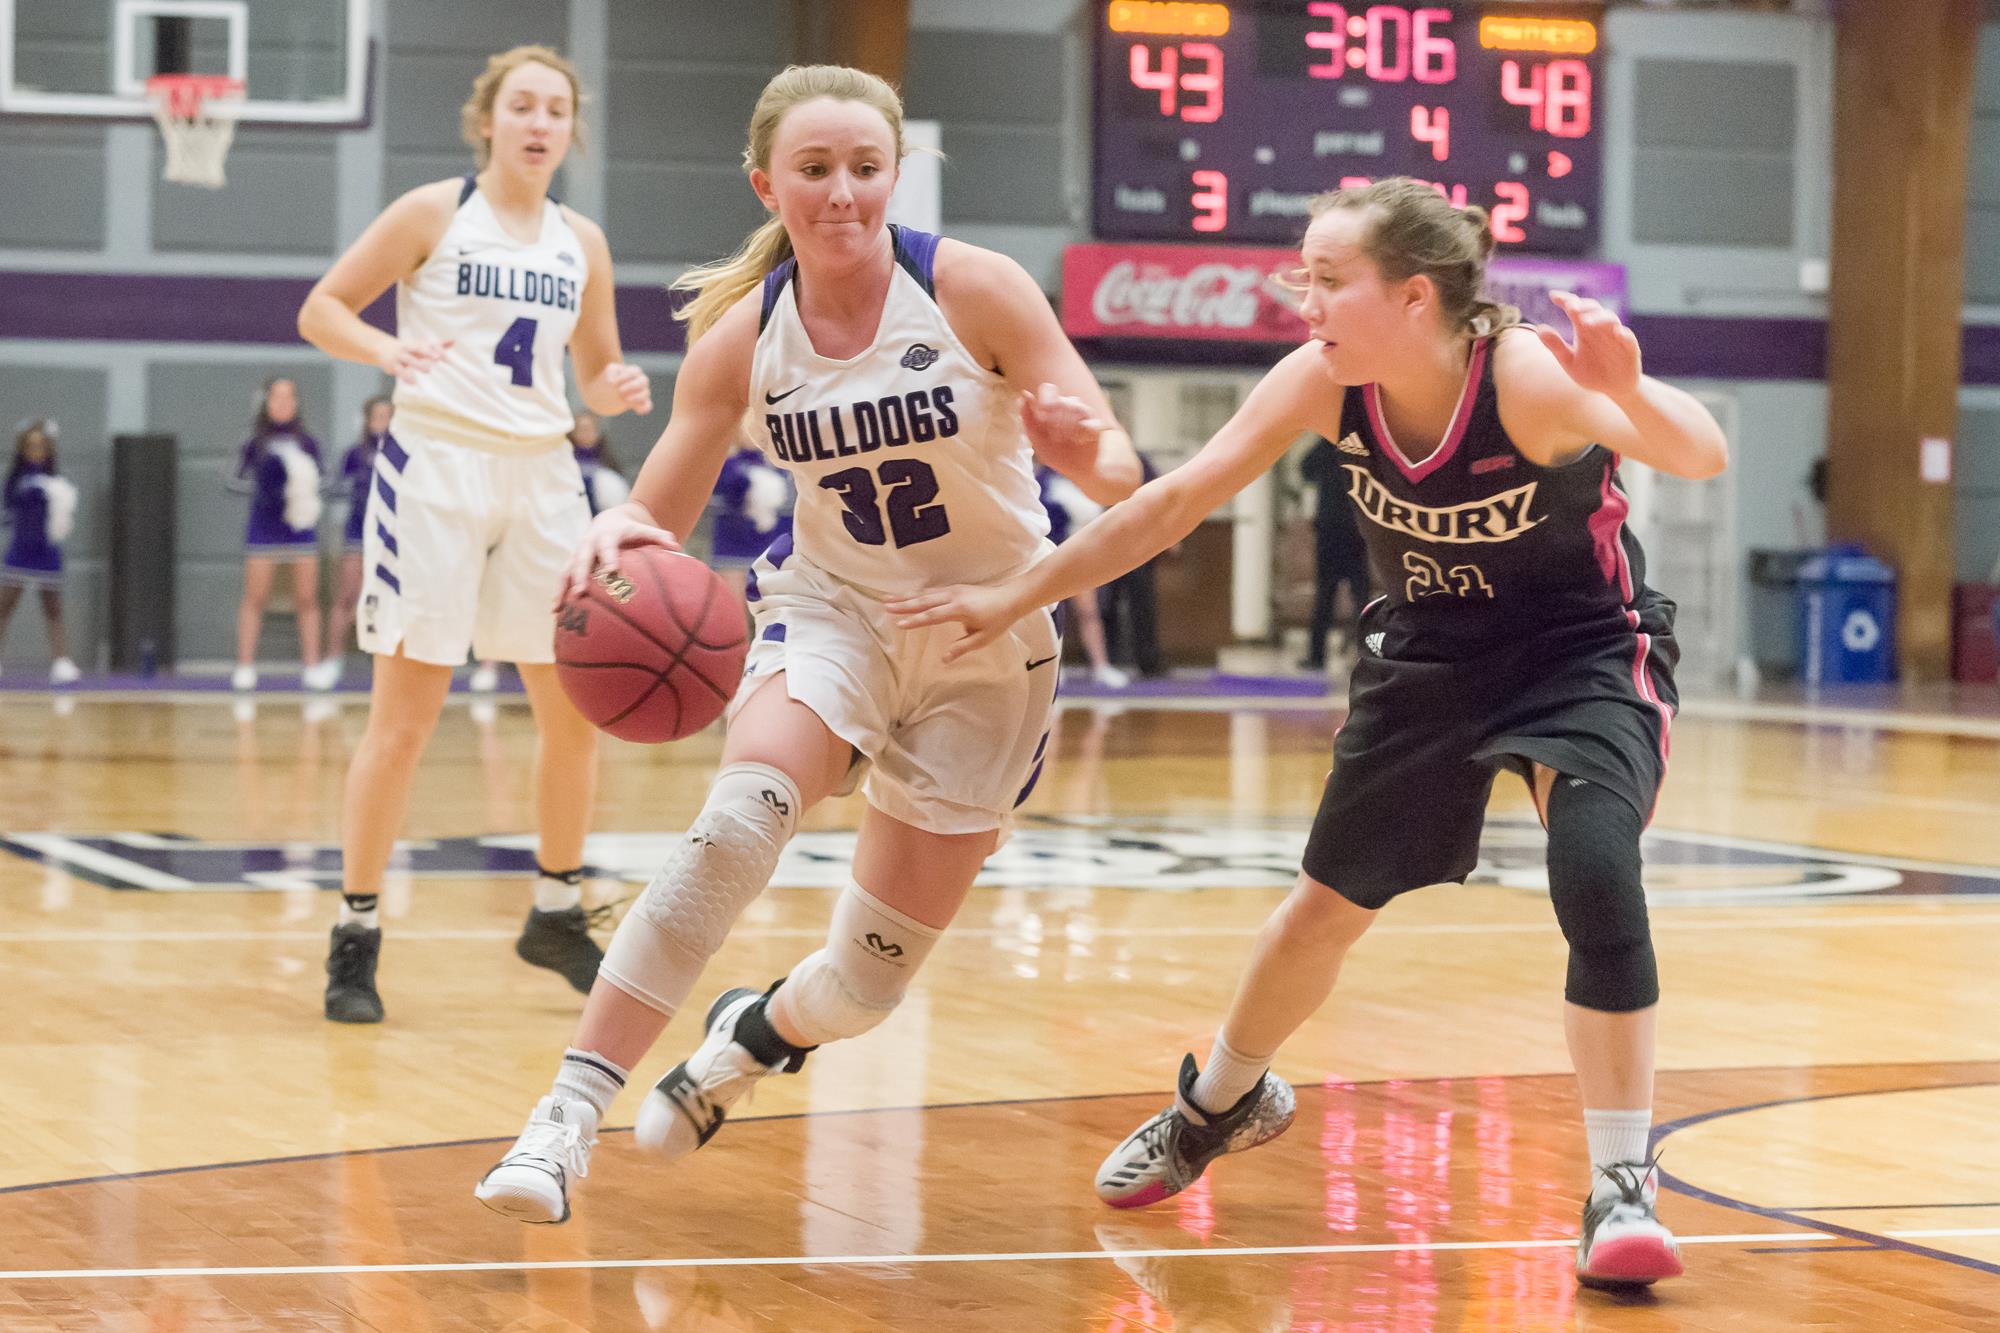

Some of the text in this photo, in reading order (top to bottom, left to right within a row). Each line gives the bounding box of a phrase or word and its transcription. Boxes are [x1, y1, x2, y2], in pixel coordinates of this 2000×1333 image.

[1306, 2, 1456, 83] 3:06
[1130, 43, 1224, 122] 43
[1501, 60, 1592, 138] 48
[1410, 105, 1449, 160] 4
[1191, 170, 1228, 231] 3
[1491, 182, 1530, 242] 2
[494, 317, 538, 388] 4
[765, 385, 959, 463] BULLDOGS
[817, 458, 951, 549] 32
